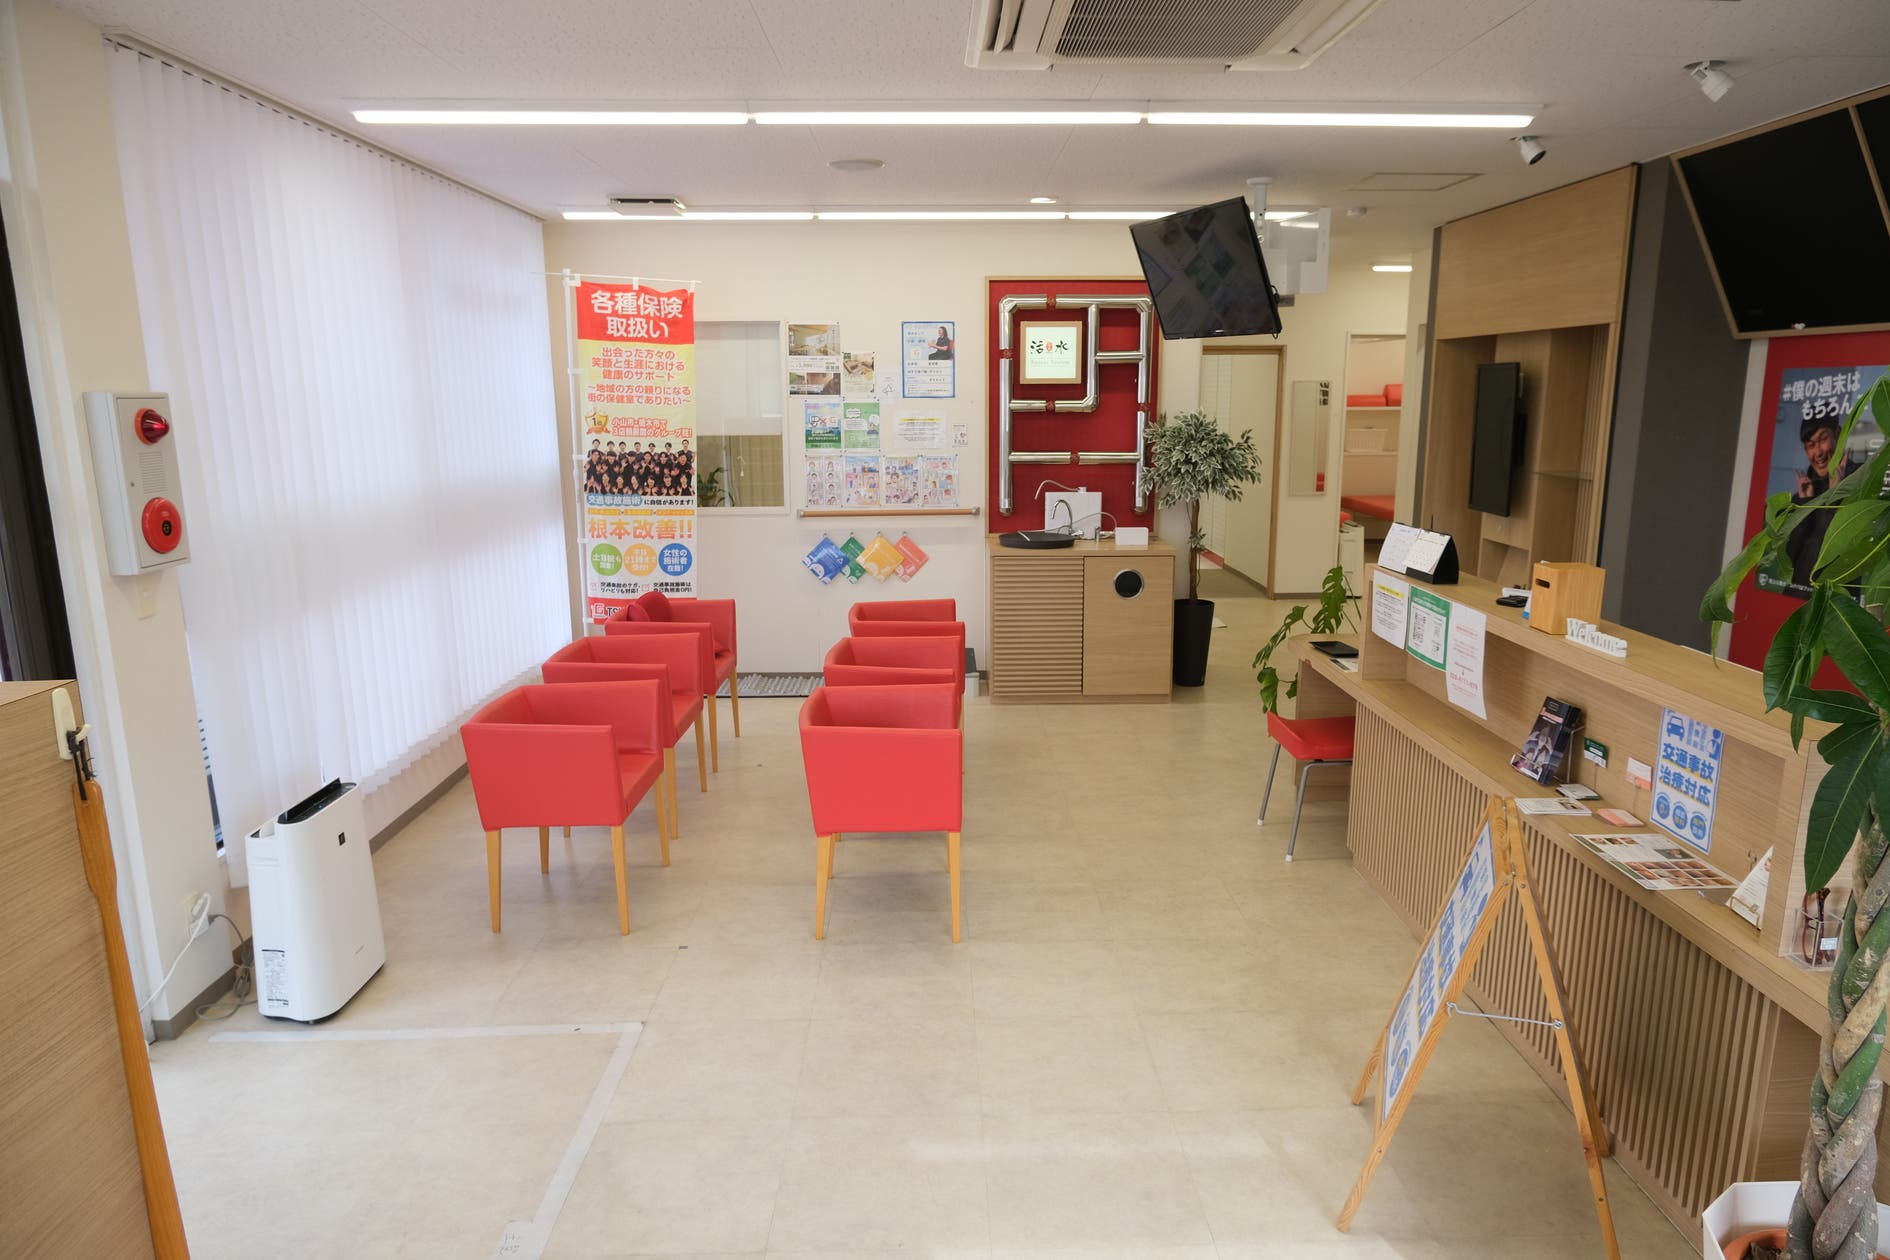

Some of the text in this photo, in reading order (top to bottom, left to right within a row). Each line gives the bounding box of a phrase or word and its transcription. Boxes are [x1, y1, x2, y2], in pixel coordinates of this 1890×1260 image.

[591, 290, 683, 318] 各種保険
[606, 316, 669, 338] 取扱い
[591, 357, 685, 371] 笑顔と生涯における
[602, 347, 675, 360] 出会った方々の
[602, 369, 675, 382] 健康のサポート
[1782, 371, 1861, 401] #僕の週末は
[588, 518, 693, 540] 根本改善!!
[663, 549, 688, 557] 女性の
[1662, 742, 1720, 781] 交通事故
[1659, 764, 1712, 806] 治療対応
